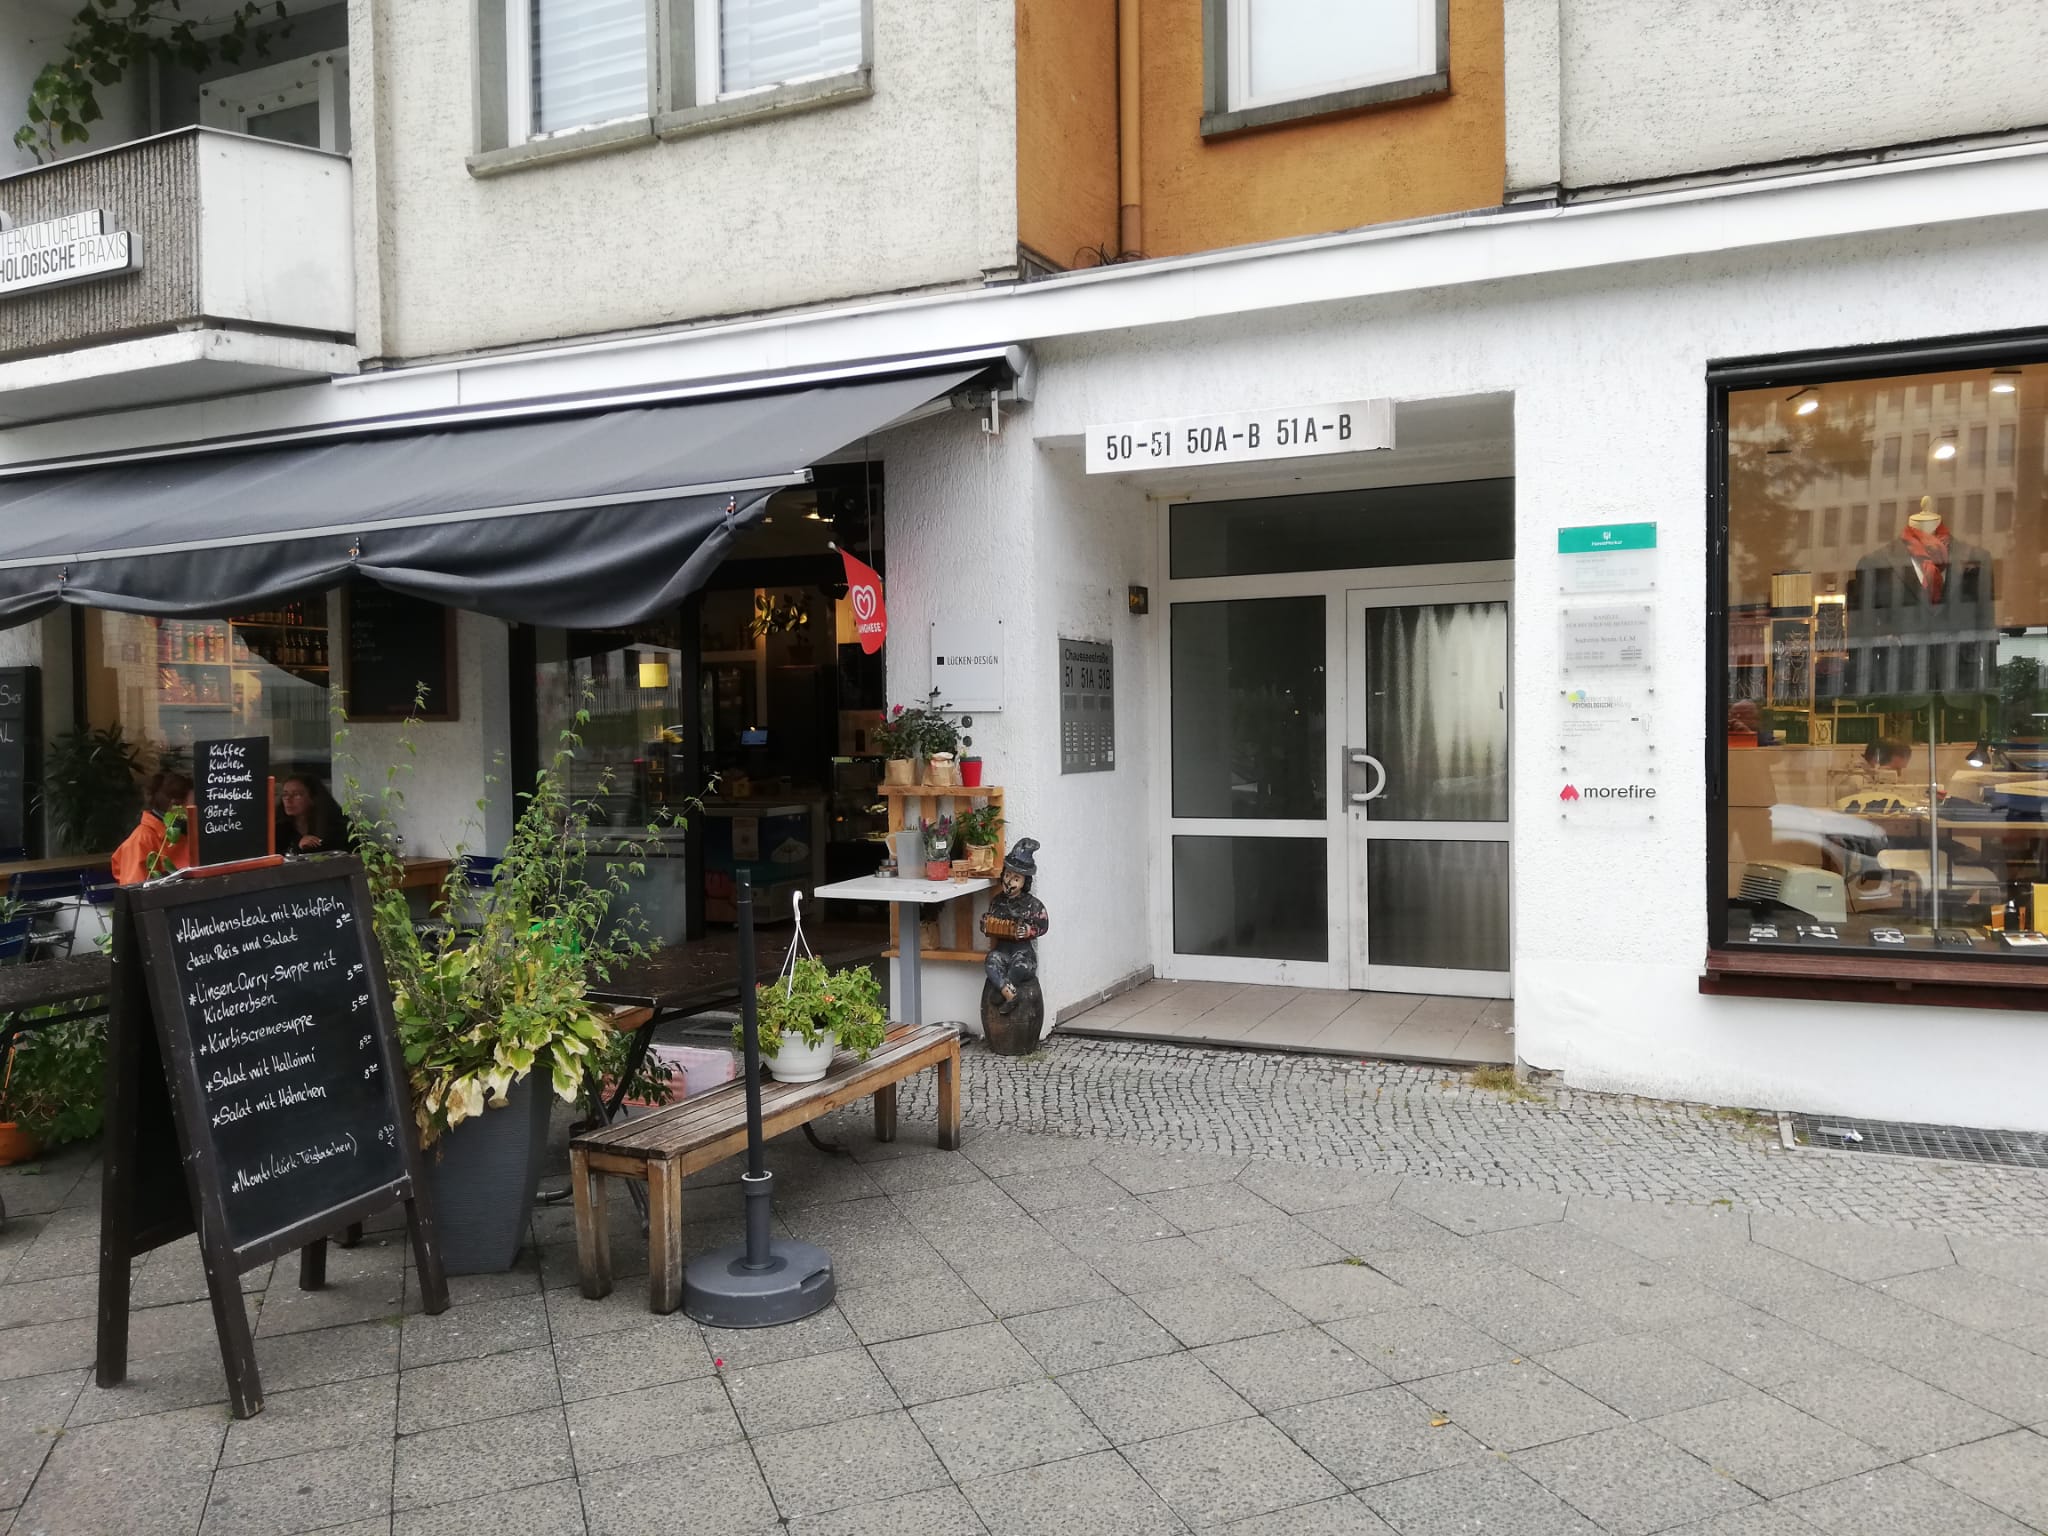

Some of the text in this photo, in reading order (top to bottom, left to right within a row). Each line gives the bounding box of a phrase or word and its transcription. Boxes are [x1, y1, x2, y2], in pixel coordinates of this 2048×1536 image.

[79, 231, 128, 268] PRAXIS
[1106, 414, 1352, 461] 50-51 50A-B 51A-B
[947, 655, 999, 666] LÜCKEN-DESIGN
[1065, 666, 1111, 690] 51 51A 51B
[209, 744, 246, 757] Kaffee
[209, 757, 244, 772] Kuchen
[207, 770, 252, 785] Croissant
[206, 787, 253, 801] Frühstück
[1584, 785, 1657, 799] morefire
[204, 803, 238, 819] Börek
[181, 896, 345, 943] Hähnchensteak mit Kartoffeln
[186, 927, 299, 971] dazu Reis und Salat
[313, 948, 337, 971] mit
[203, 993, 278, 1025] Kichererbsen
[213, 1062, 248, 1091] Salat
[249, 1057, 271, 1080] mit
[219, 1082, 327, 1126] Salat mit Hähnchen
